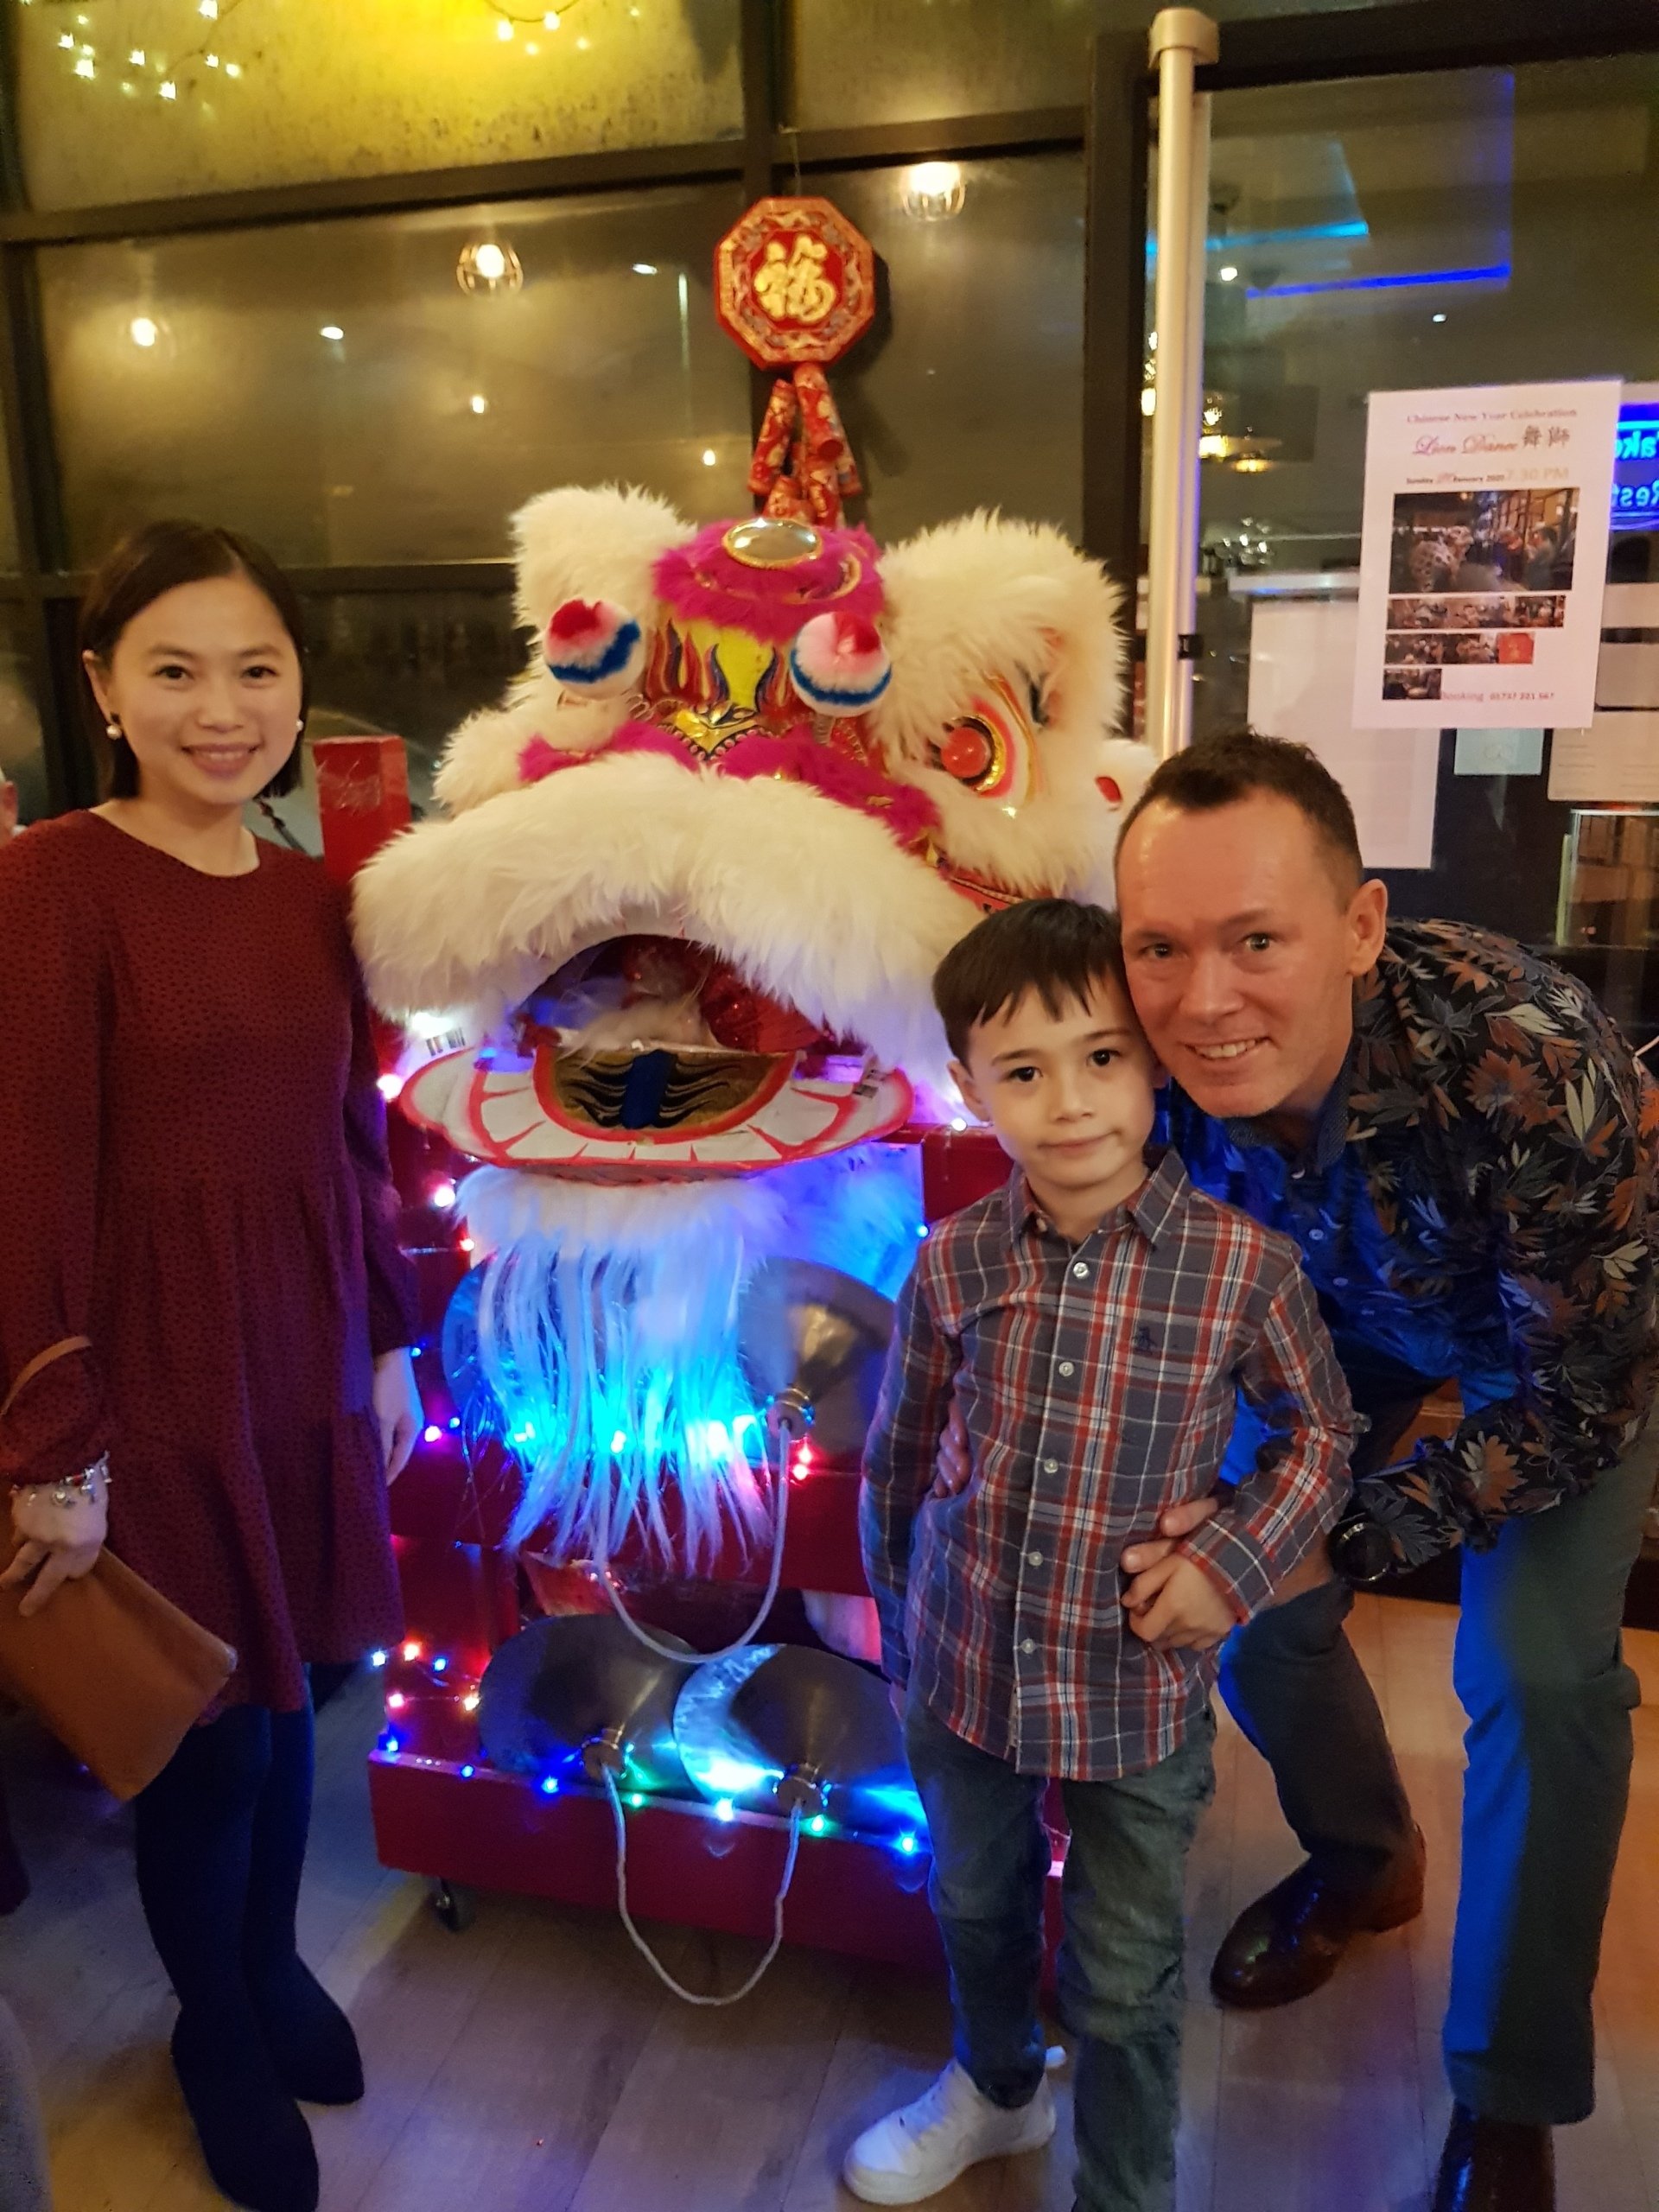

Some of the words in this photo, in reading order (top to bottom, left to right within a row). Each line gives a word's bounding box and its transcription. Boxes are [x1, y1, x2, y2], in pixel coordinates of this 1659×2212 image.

[1407, 413, 1451, 423] Chinese
[1454, 412, 1478, 422] New
[1482, 410, 1507, 421] Year
[1510, 408, 1578, 420] Celebration
